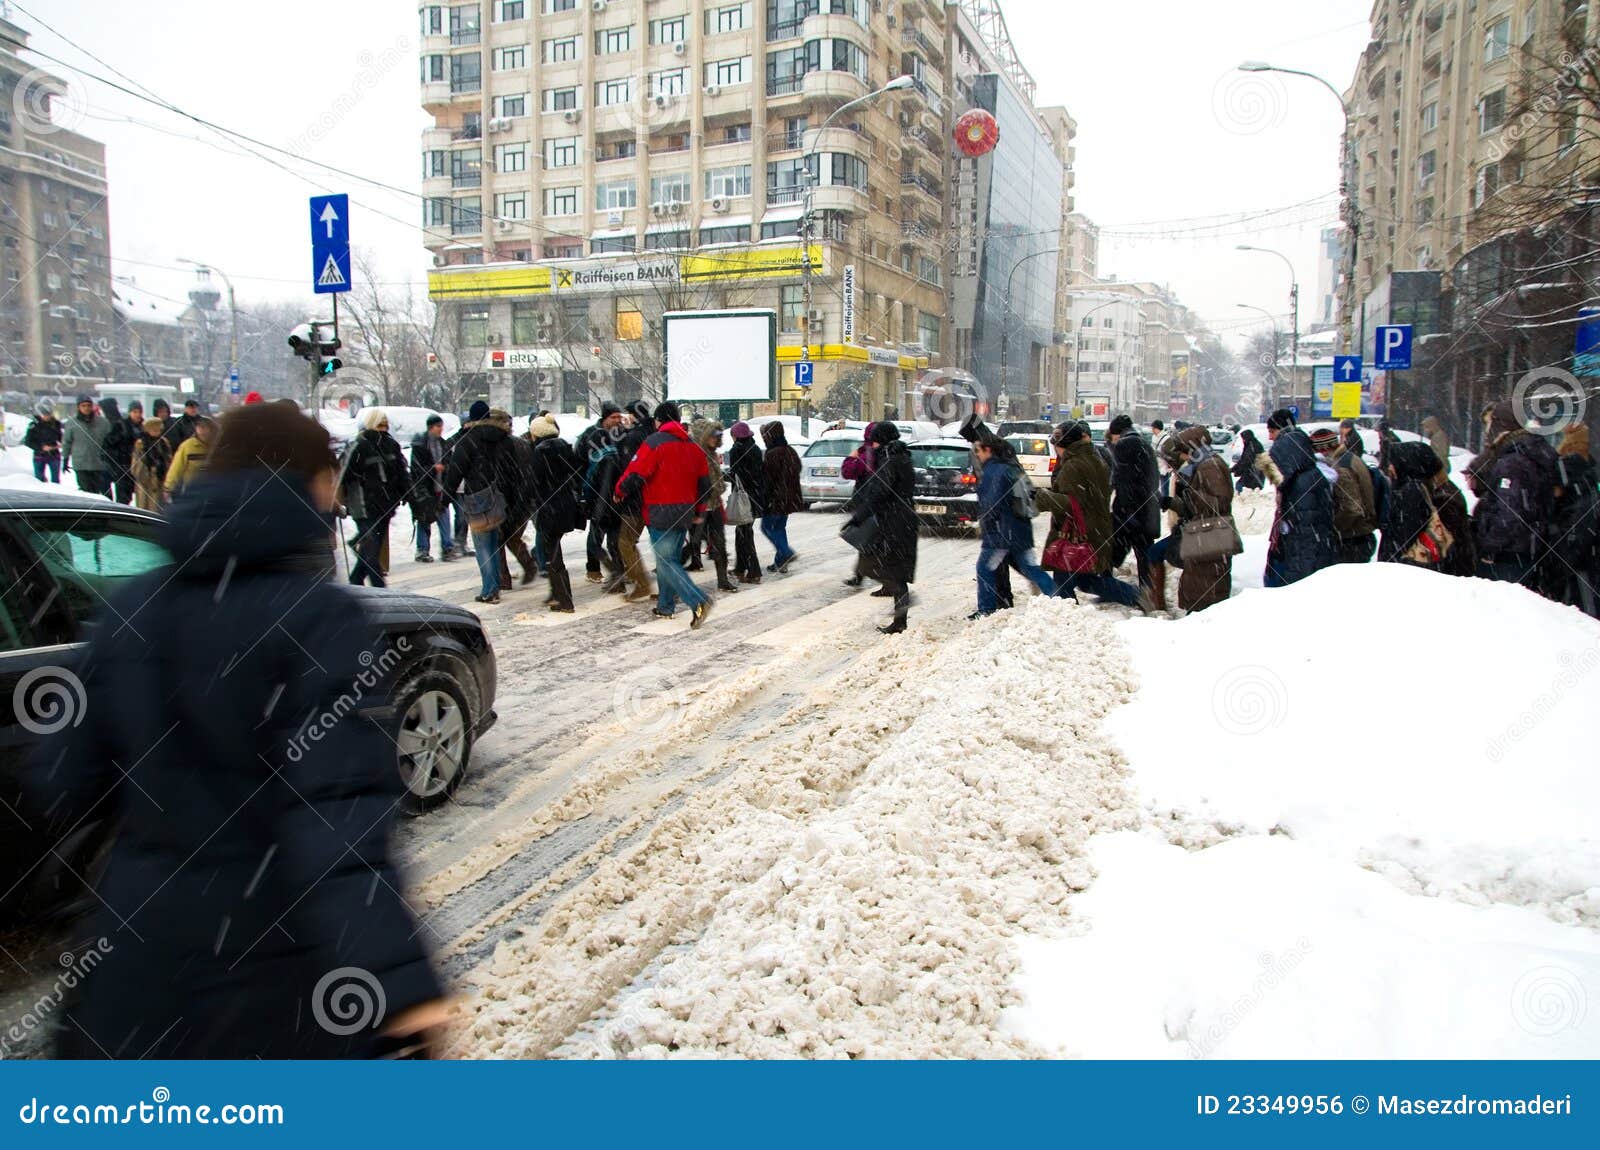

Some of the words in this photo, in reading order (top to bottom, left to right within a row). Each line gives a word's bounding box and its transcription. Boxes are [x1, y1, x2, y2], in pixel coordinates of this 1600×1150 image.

[575, 270, 634, 284] Raiffeisen
[637, 265, 674, 280] BANK
[845, 268, 853, 294] BANK
[1384, 328, 1403, 363] P
[509, 353, 537, 364] BRD
[799, 363, 809, 382] P
